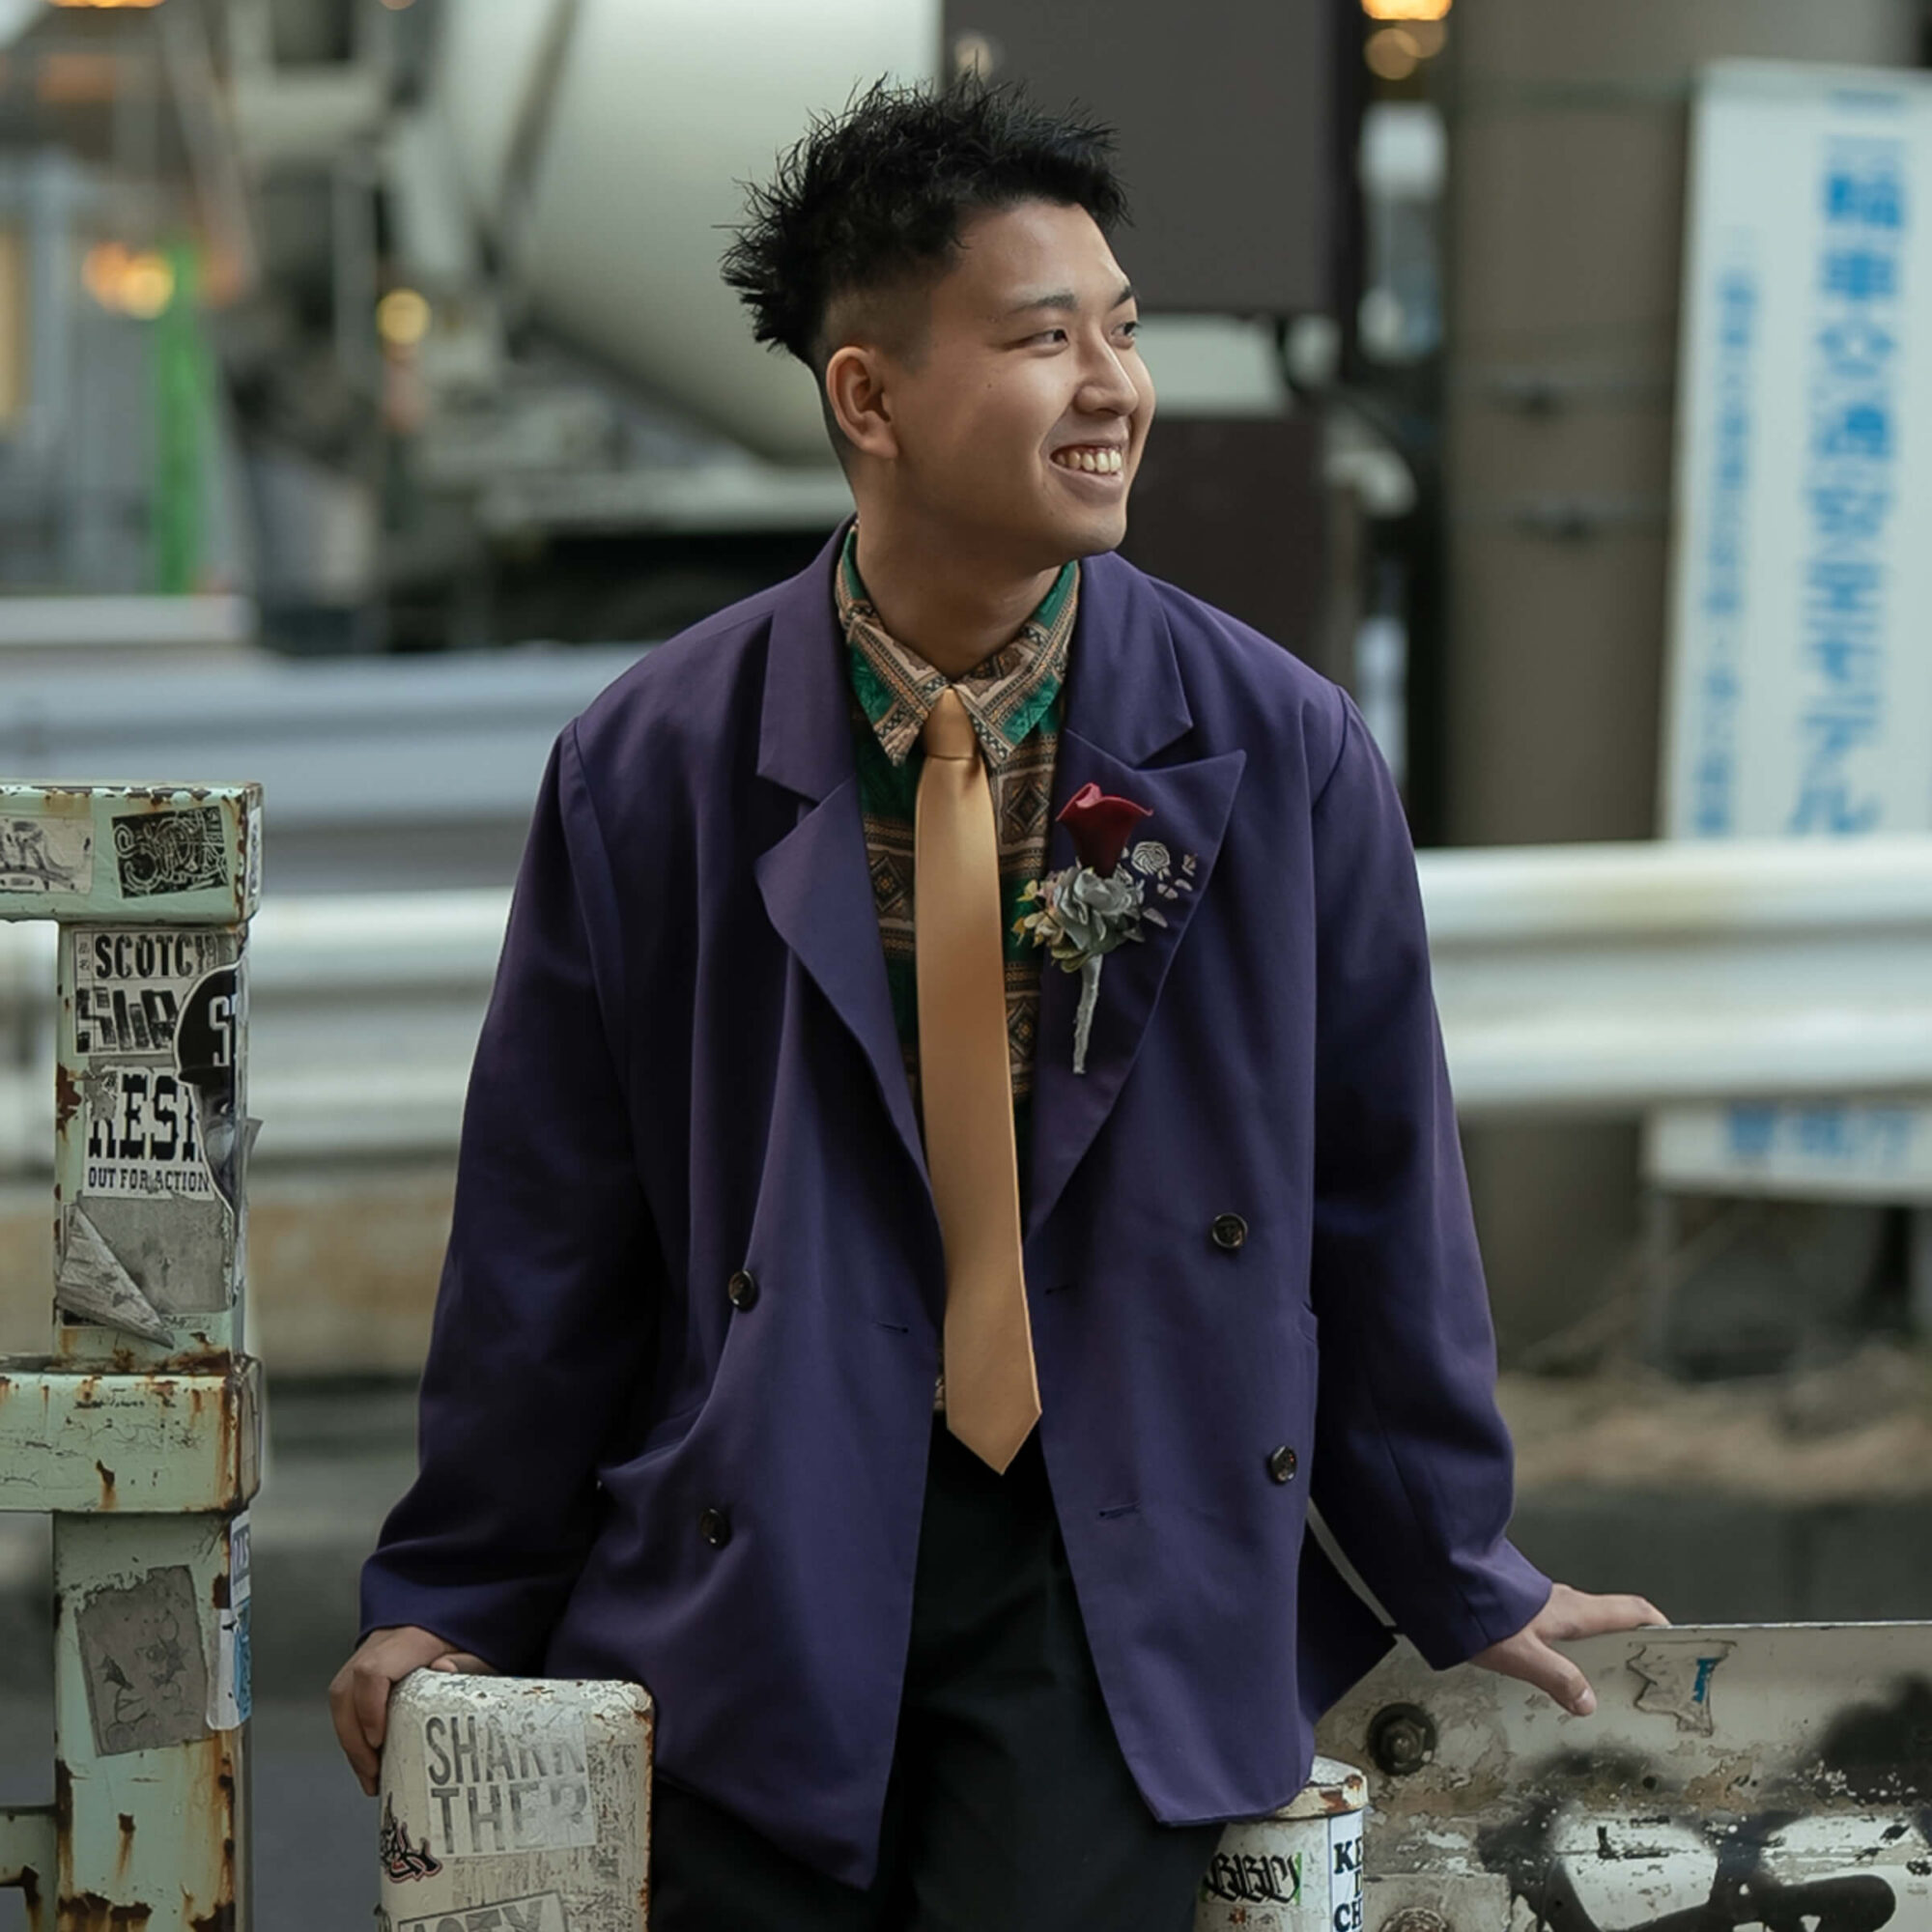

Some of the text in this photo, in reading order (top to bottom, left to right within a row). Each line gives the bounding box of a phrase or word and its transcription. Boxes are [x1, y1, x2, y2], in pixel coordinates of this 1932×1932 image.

[88, 1166, 211, 1193] OUT FOR ACTION
